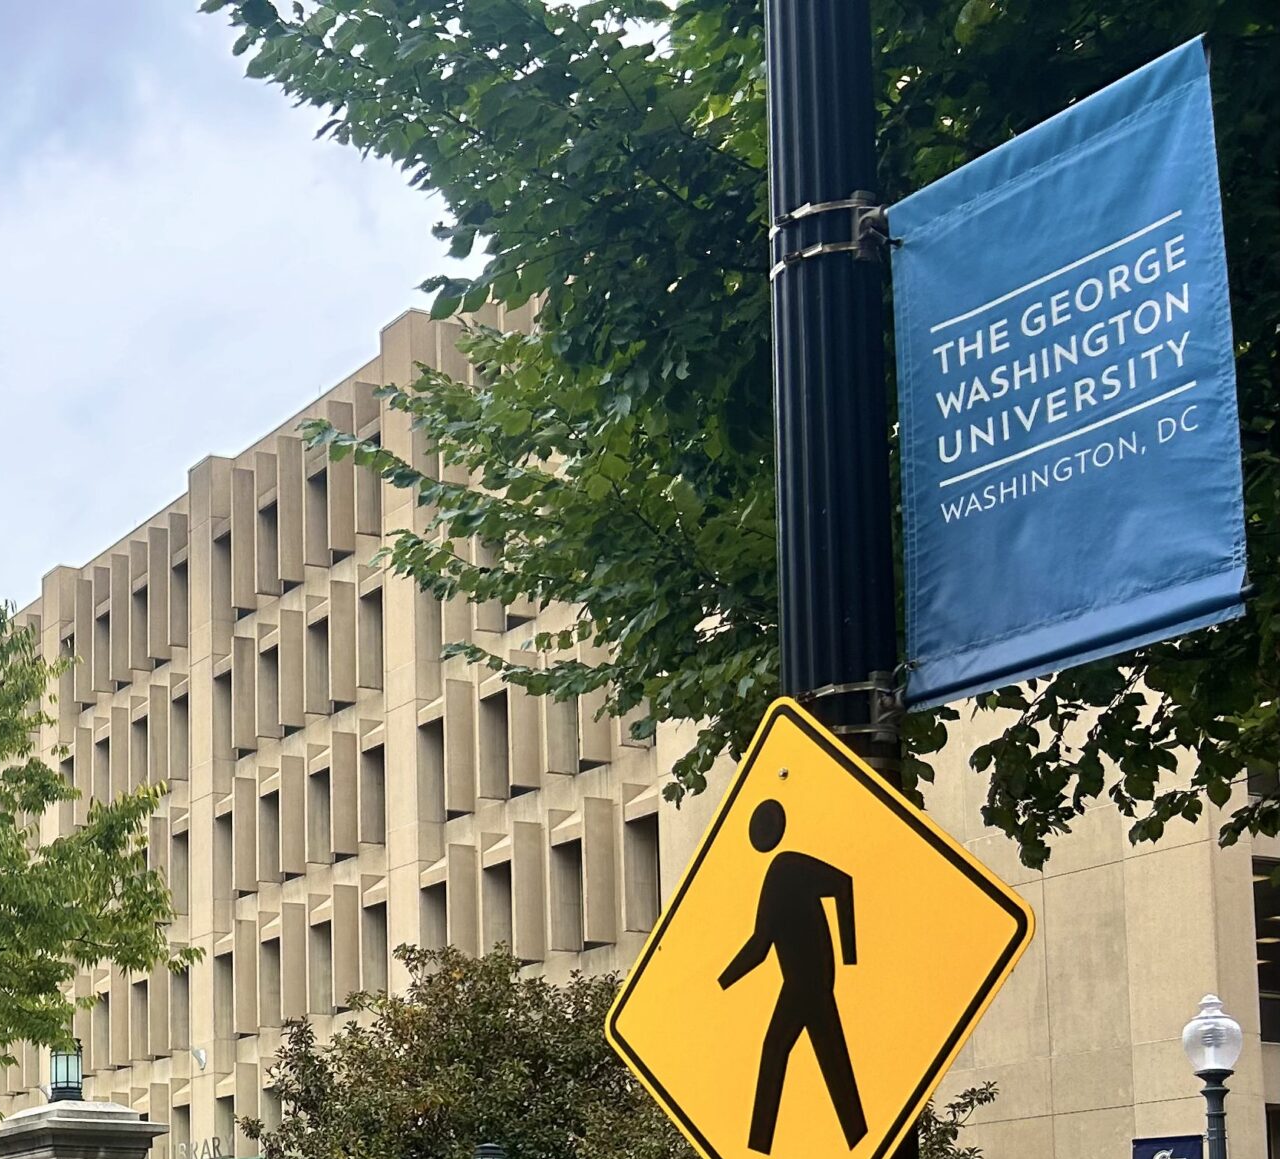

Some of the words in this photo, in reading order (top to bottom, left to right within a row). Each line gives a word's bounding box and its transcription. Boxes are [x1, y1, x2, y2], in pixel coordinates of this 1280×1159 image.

[932, 318, 1011, 375] THE
[1021, 233, 1188, 338] GEORGE
[935, 283, 1191, 420] WASHINGTON
[937, 330, 1192, 464] UNIVERSITY
[940, 431, 1147, 524] WASHINGTON,
[1156, 404, 1200, 444] DC
